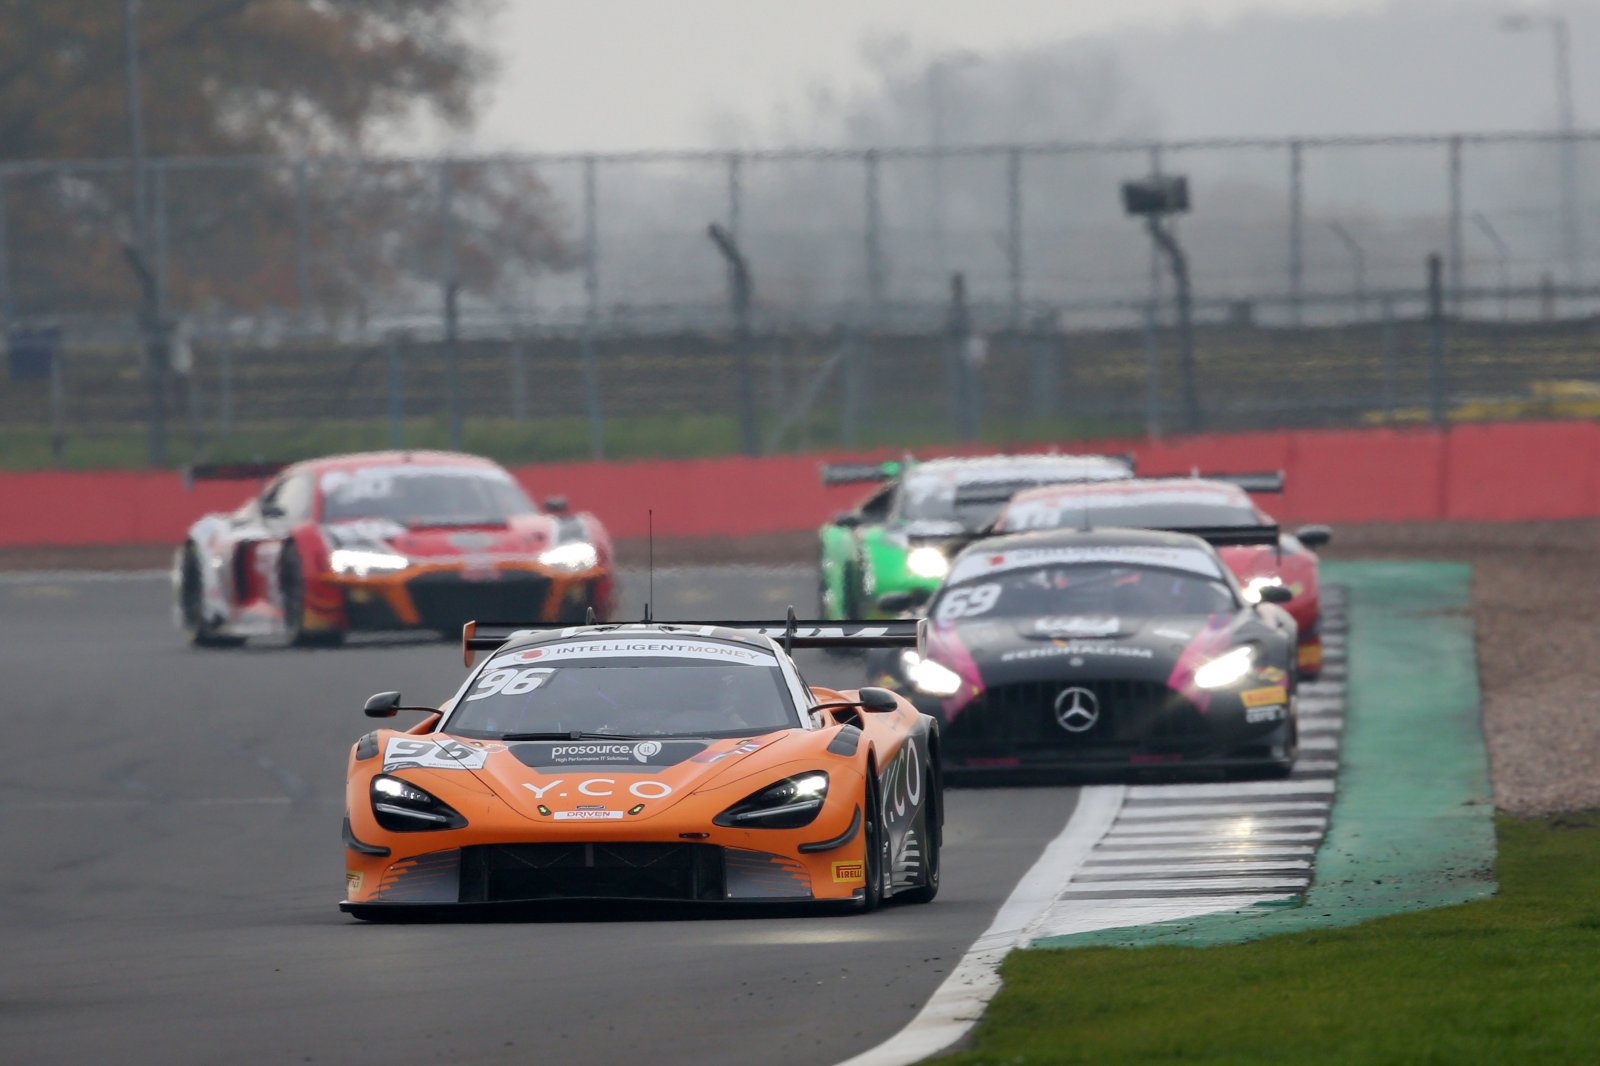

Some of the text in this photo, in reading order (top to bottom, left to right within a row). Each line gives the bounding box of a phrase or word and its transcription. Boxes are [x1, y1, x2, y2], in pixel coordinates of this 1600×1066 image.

[937, 583, 1002, 622] 69
[466, 667, 557, 701] 96
[389, 741, 475, 761] 96
[566, 811, 611, 819] DRIVEN
[835, 864, 863, 879] PIRELLI
